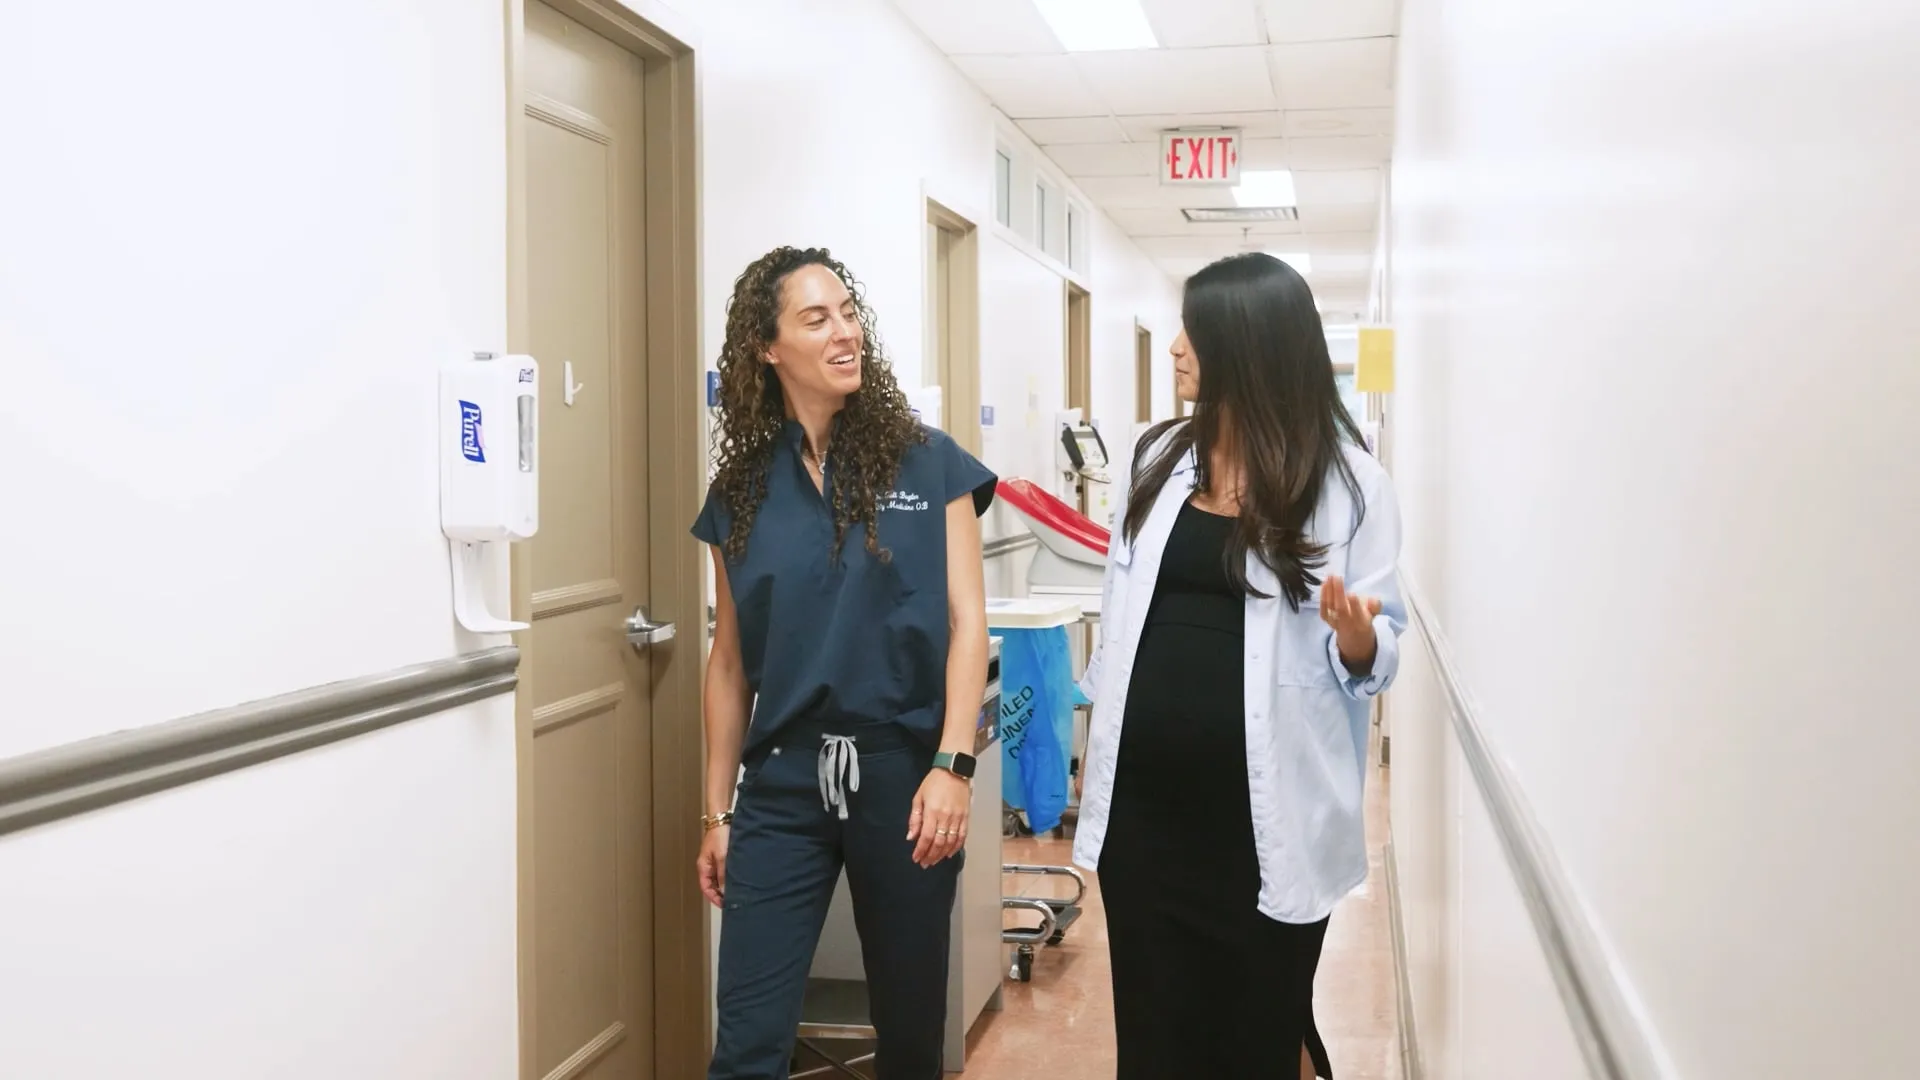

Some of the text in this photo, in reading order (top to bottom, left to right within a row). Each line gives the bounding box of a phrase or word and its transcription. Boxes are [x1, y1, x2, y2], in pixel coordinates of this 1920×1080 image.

[1171, 137, 1232, 179] EXIT
[463, 406, 480, 457] Purell
[1001, 685, 1034, 718] ILED
